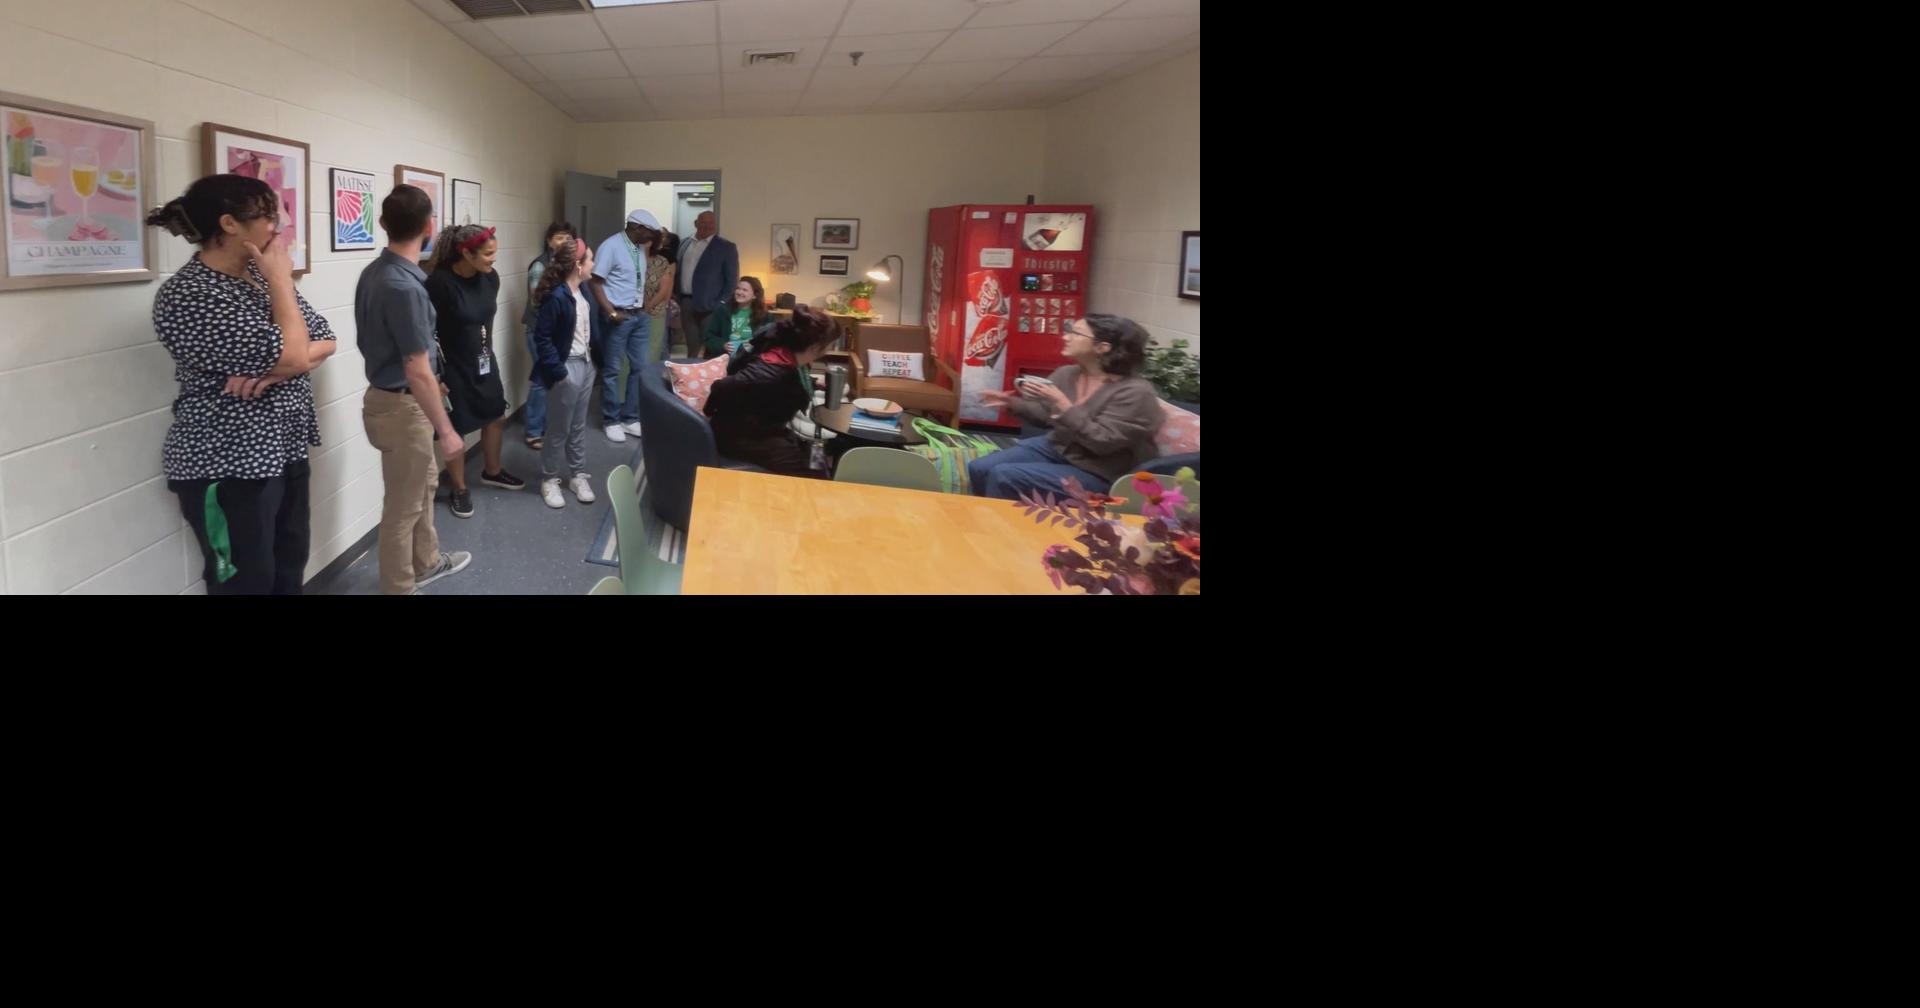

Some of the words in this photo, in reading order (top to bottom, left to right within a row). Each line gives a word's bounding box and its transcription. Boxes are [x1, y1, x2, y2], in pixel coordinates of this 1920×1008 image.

[27, 244, 127, 258] CHAMPAGNE
[1024, 257, 1076, 271] Thirsty?
[882, 360, 908, 368] TEACH
